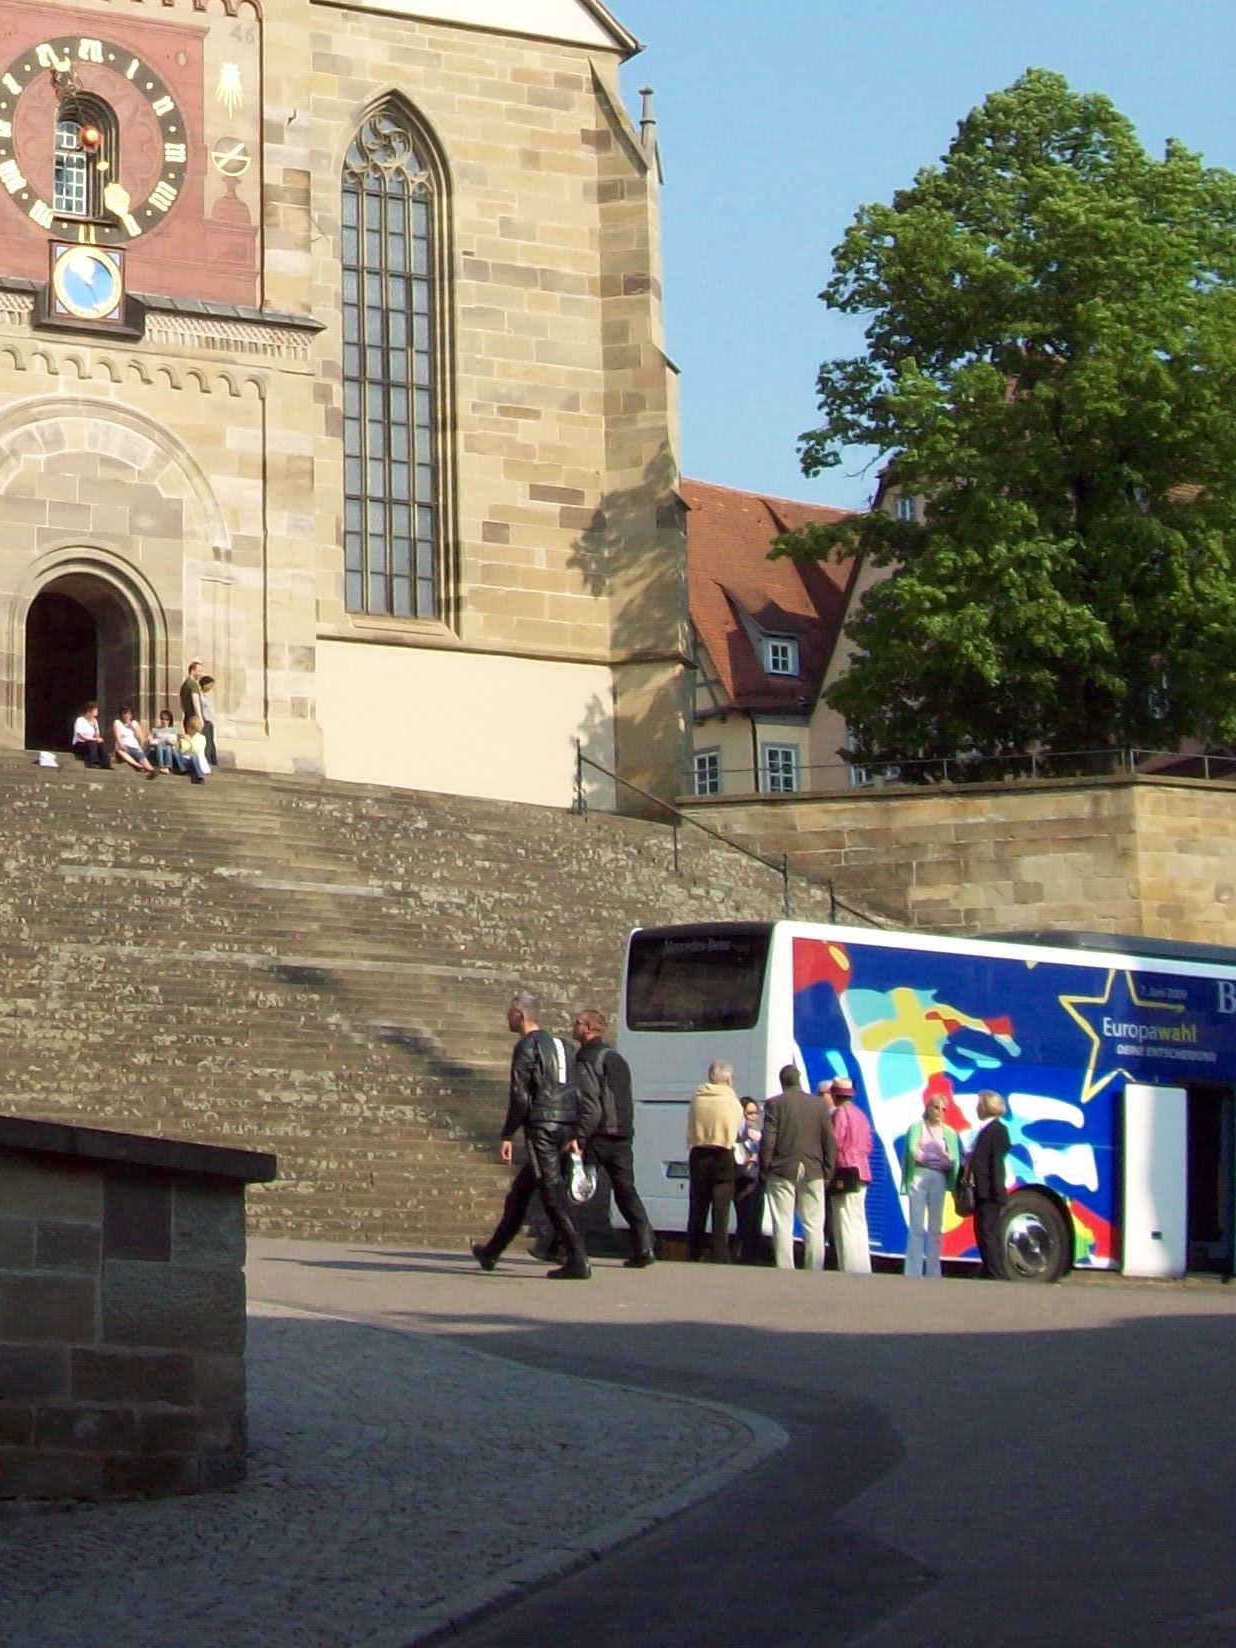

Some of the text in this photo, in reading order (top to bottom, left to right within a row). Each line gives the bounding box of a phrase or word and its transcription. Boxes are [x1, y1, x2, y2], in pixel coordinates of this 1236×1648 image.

[126, 59, 139, 79] I
[152, 95, 174, 116] II
[164, 143, 186, 162] III
[1102, 1016, 1197, 1044] Europawahl
